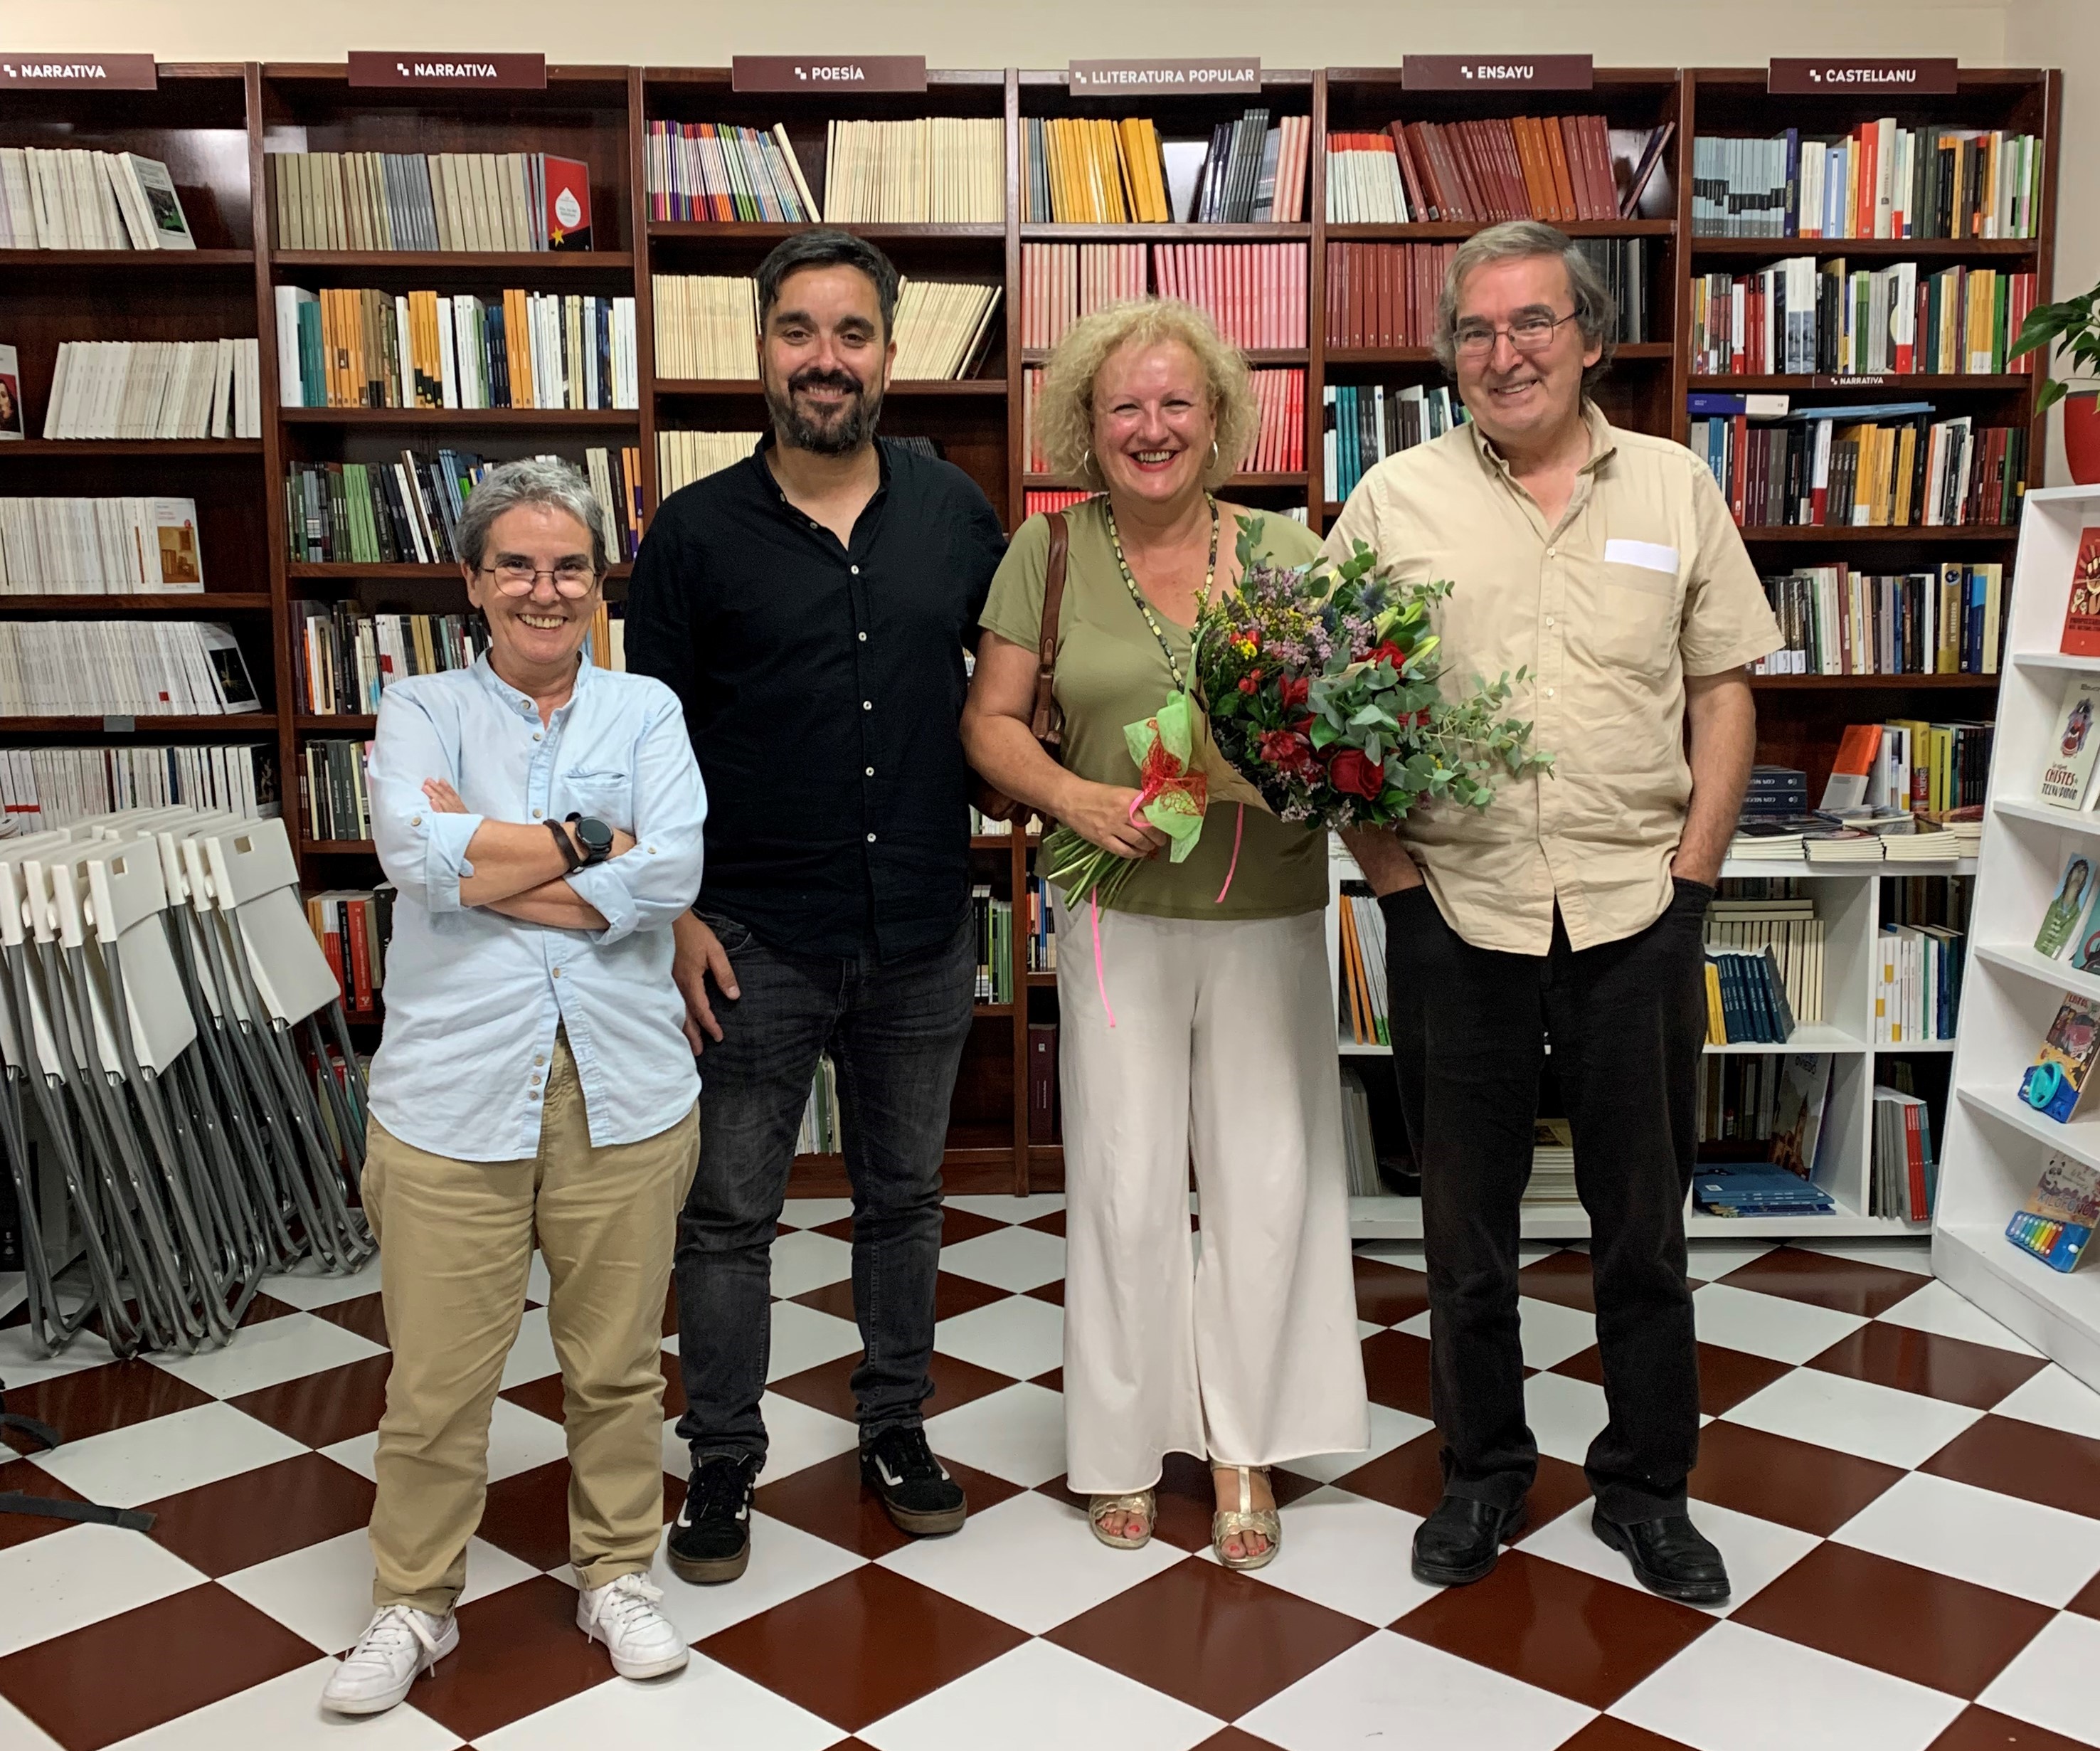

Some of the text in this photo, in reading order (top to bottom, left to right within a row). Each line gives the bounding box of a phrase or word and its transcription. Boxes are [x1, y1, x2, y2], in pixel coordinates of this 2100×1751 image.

[21, 65, 106, 78] NARRATIVA
[414, 63, 497, 77] NARRATIVA
[812, 64, 865, 80] POESÍA
[1092, 68, 1255, 84] LLITERATURA POPULAR
[1478, 65, 1534, 79] ENSAYU
[1825, 69, 1916, 83] CASTELLANU
[1840, 376, 1884, 385] NARRATIVA
